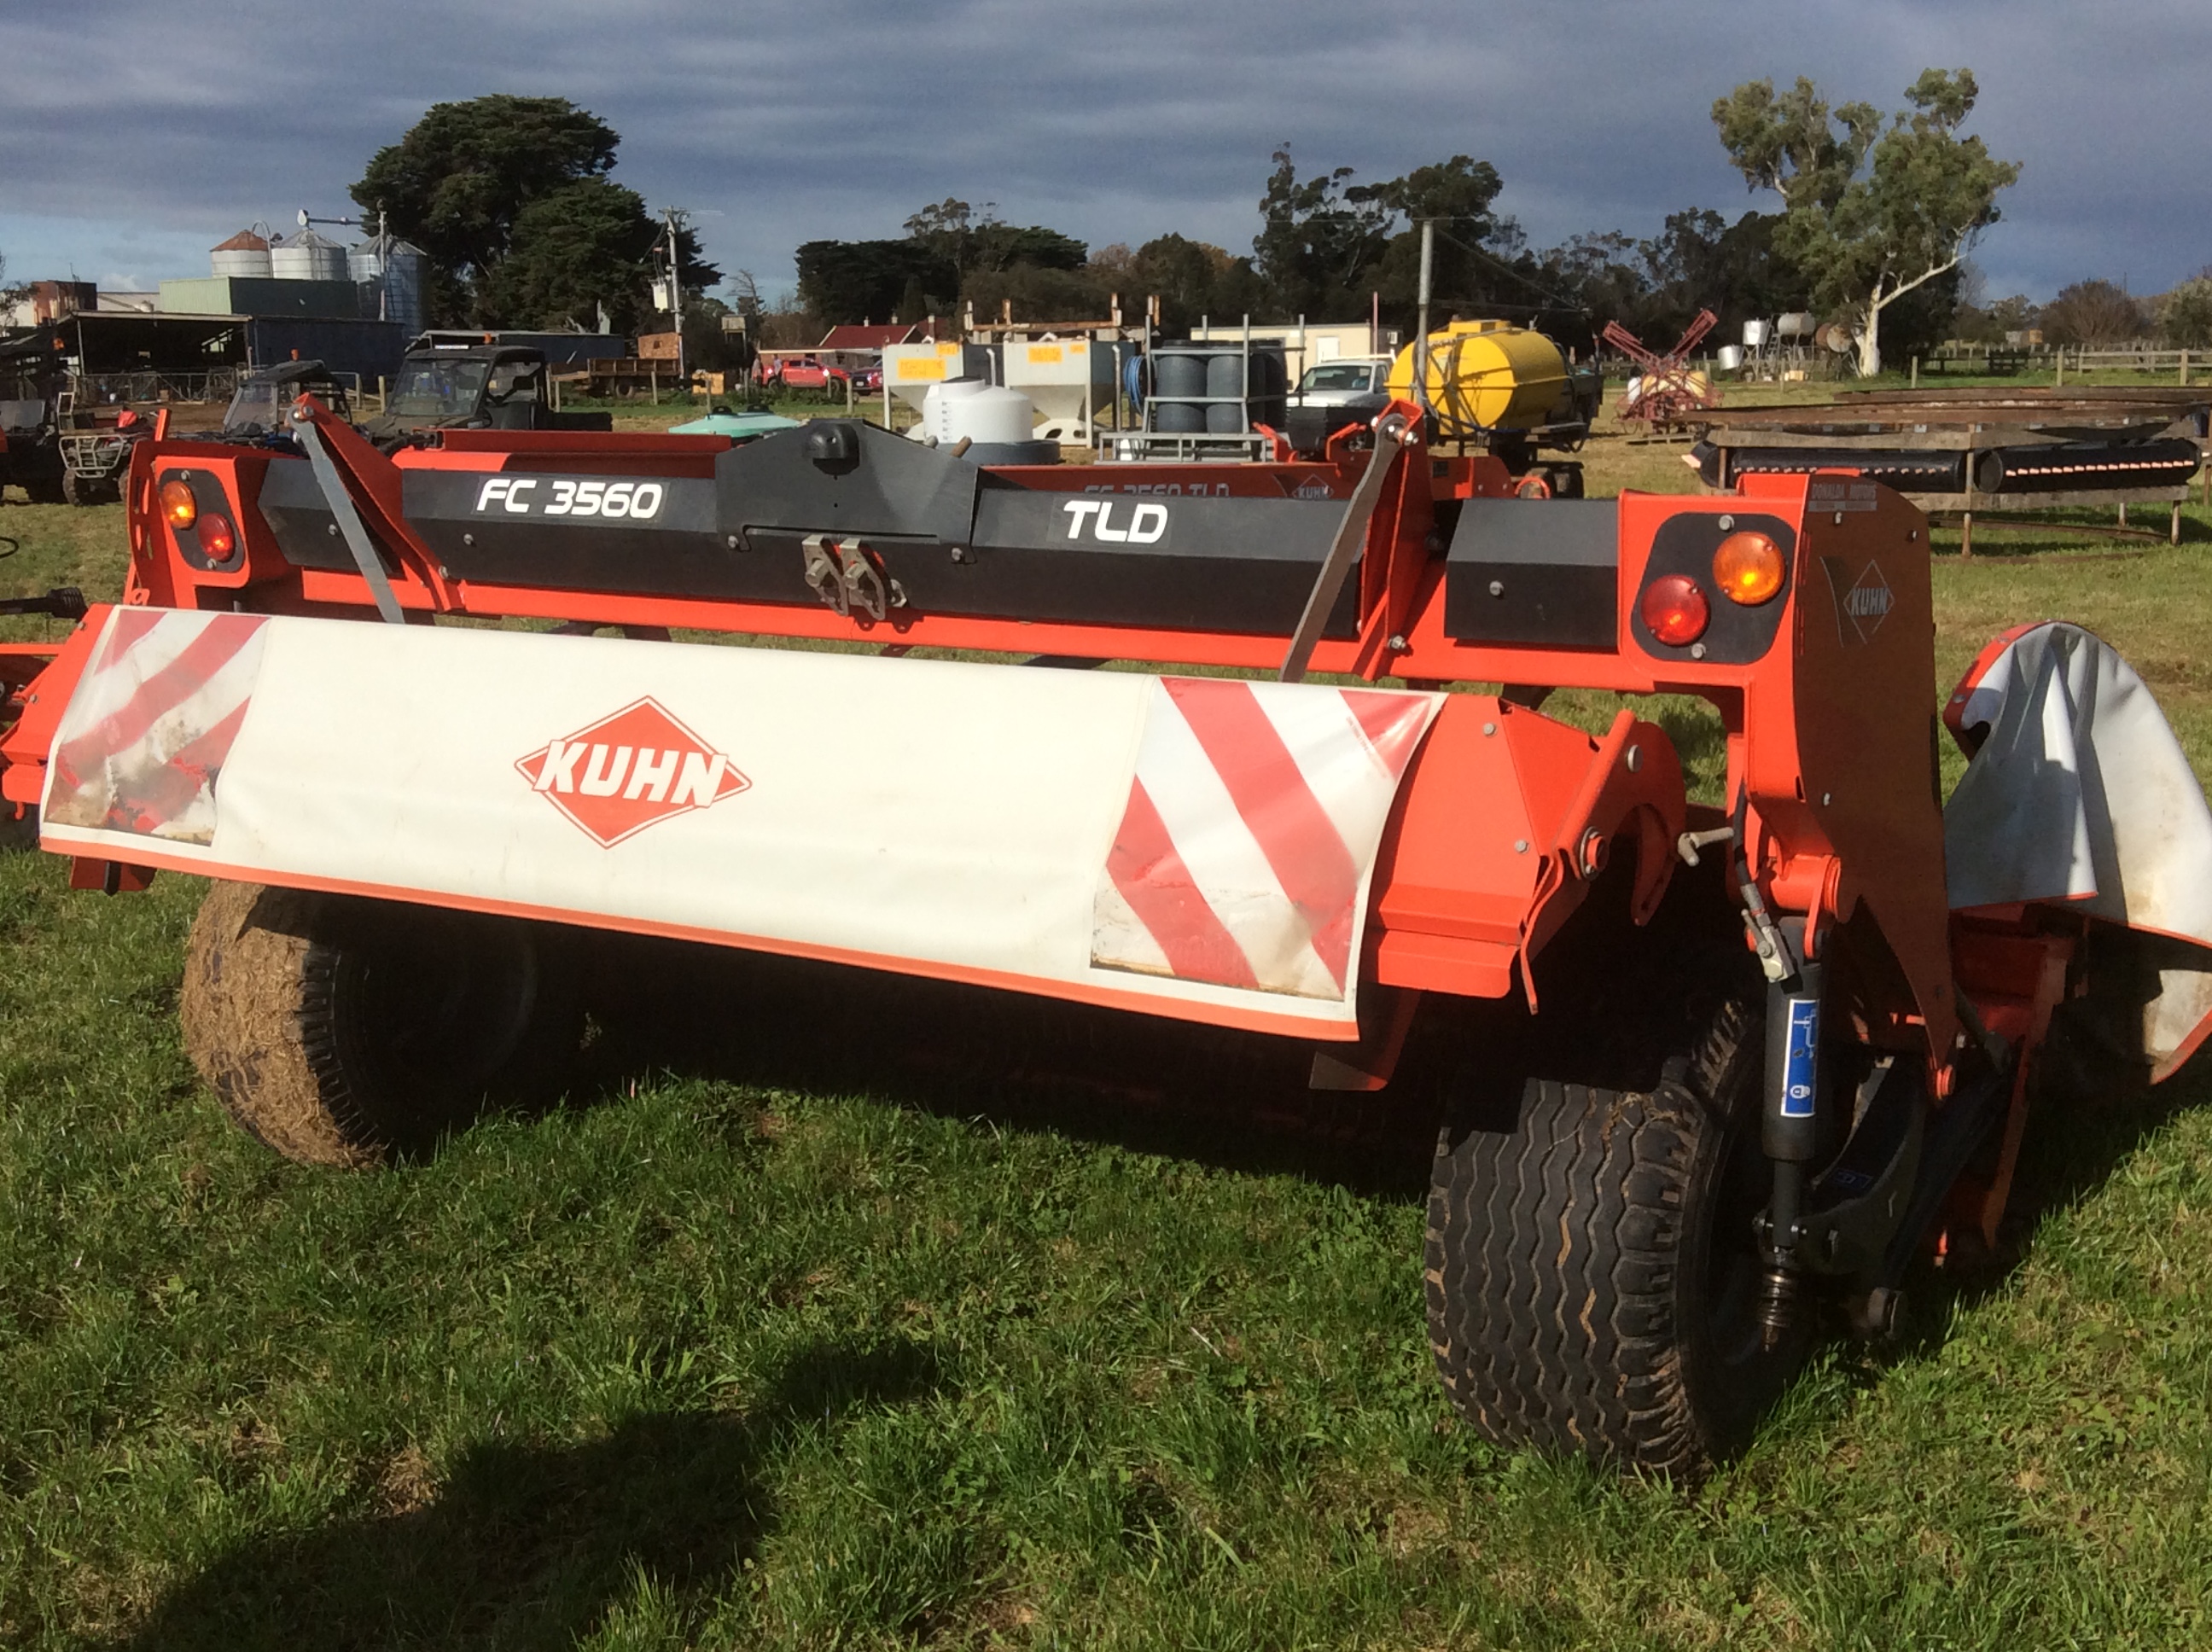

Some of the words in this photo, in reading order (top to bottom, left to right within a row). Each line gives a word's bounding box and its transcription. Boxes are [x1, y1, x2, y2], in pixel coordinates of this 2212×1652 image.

[476, 479, 538, 513] FC
[544, 480, 663, 519] 3560
[1063, 500, 1168, 544] TLD
[1850, 587, 1889, 616] KUHN
[532, 739, 729, 809] KUHN
